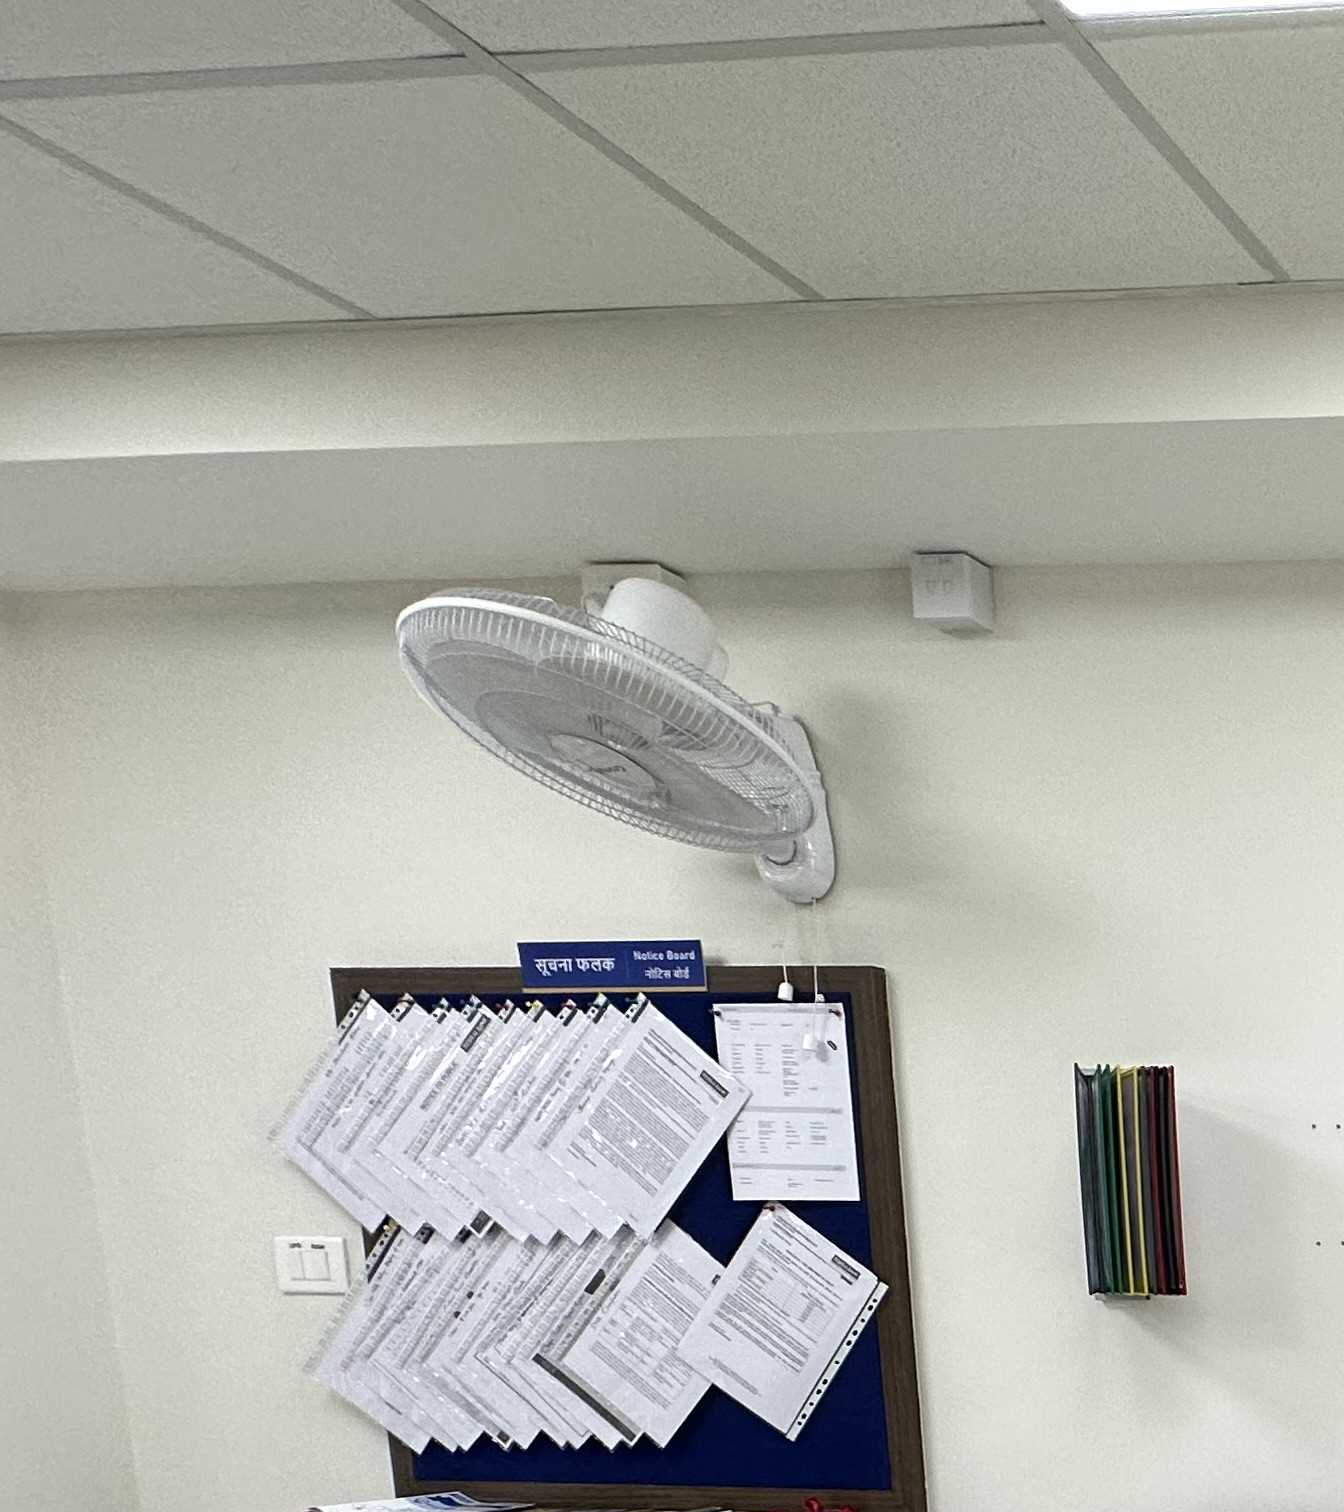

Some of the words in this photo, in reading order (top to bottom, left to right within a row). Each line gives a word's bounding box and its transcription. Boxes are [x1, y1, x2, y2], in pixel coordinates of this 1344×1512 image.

[633, 951, 664, 961] Notice
[667, 950, 695, 960] Board
[534, 958, 572, 976] सूचना
[576, 958, 615, 972] फलक
[645, 967, 671, 980] नोटिस
